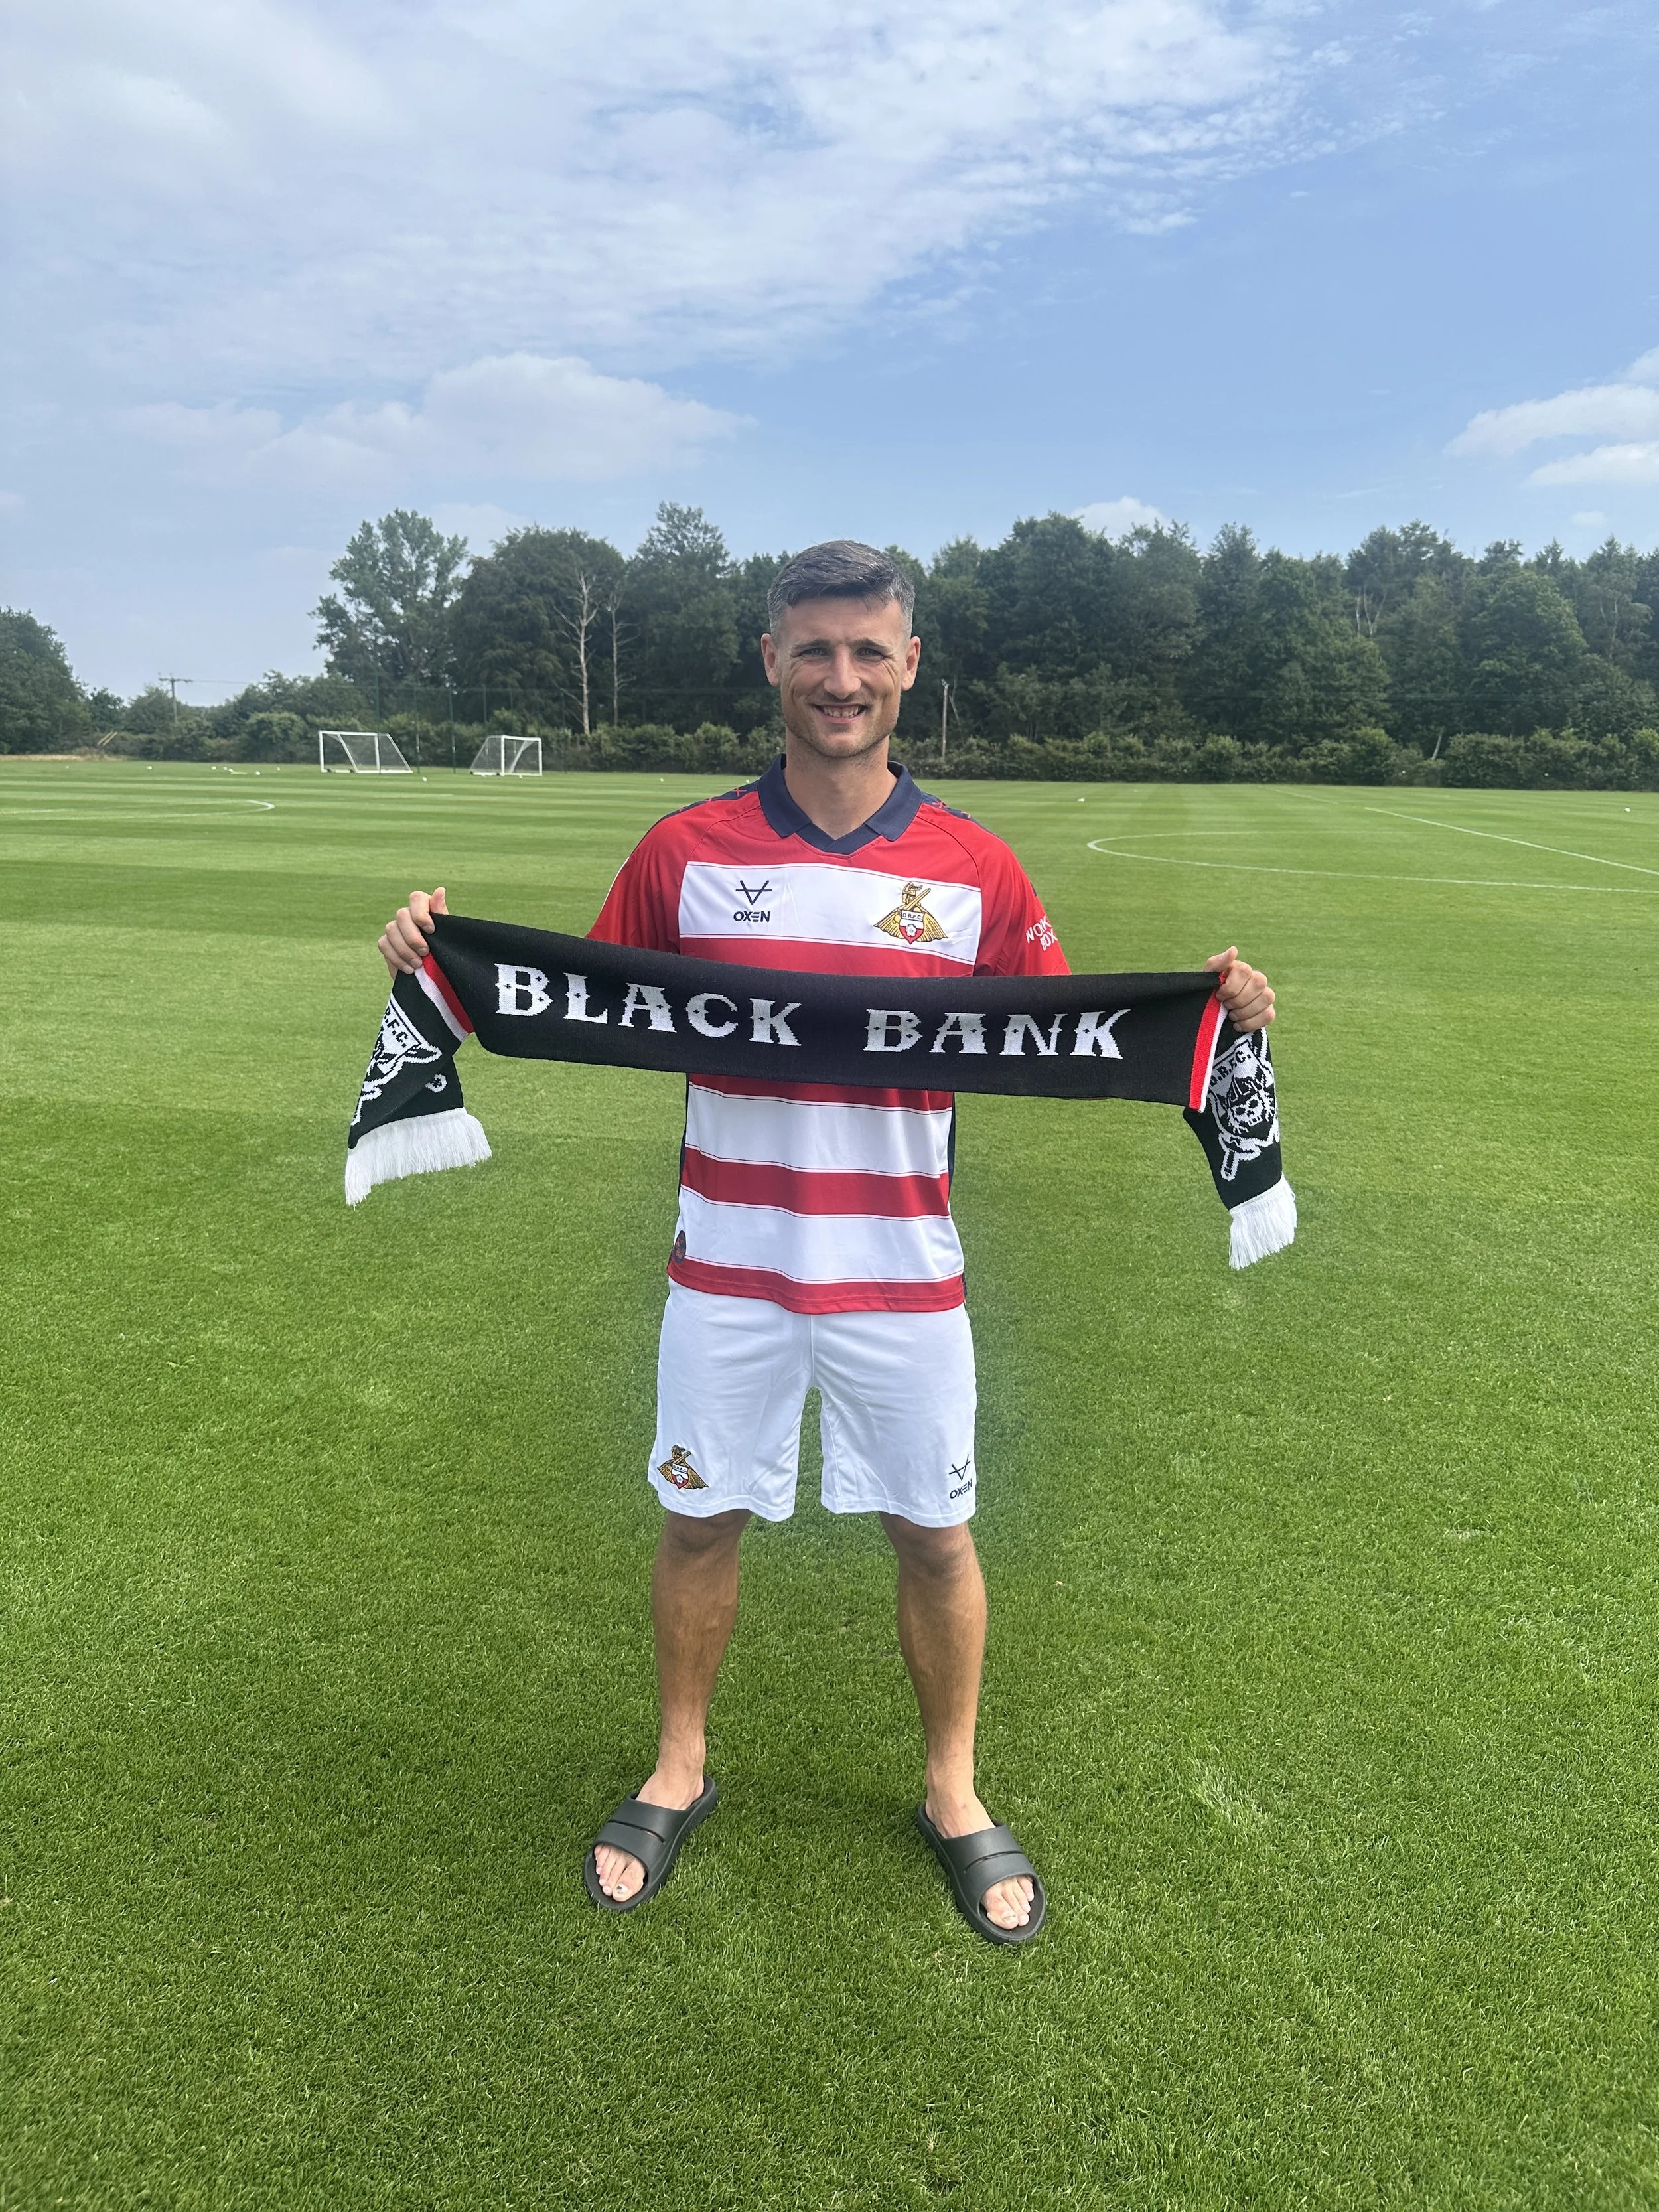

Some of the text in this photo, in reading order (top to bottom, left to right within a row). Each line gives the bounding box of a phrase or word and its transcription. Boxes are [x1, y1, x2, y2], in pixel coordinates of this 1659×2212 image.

[733, 911, 770, 922] OXEN
[494, 963, 1131, 1059] BLACK BANK
[950, 1477, 972, 1499] OXEN
